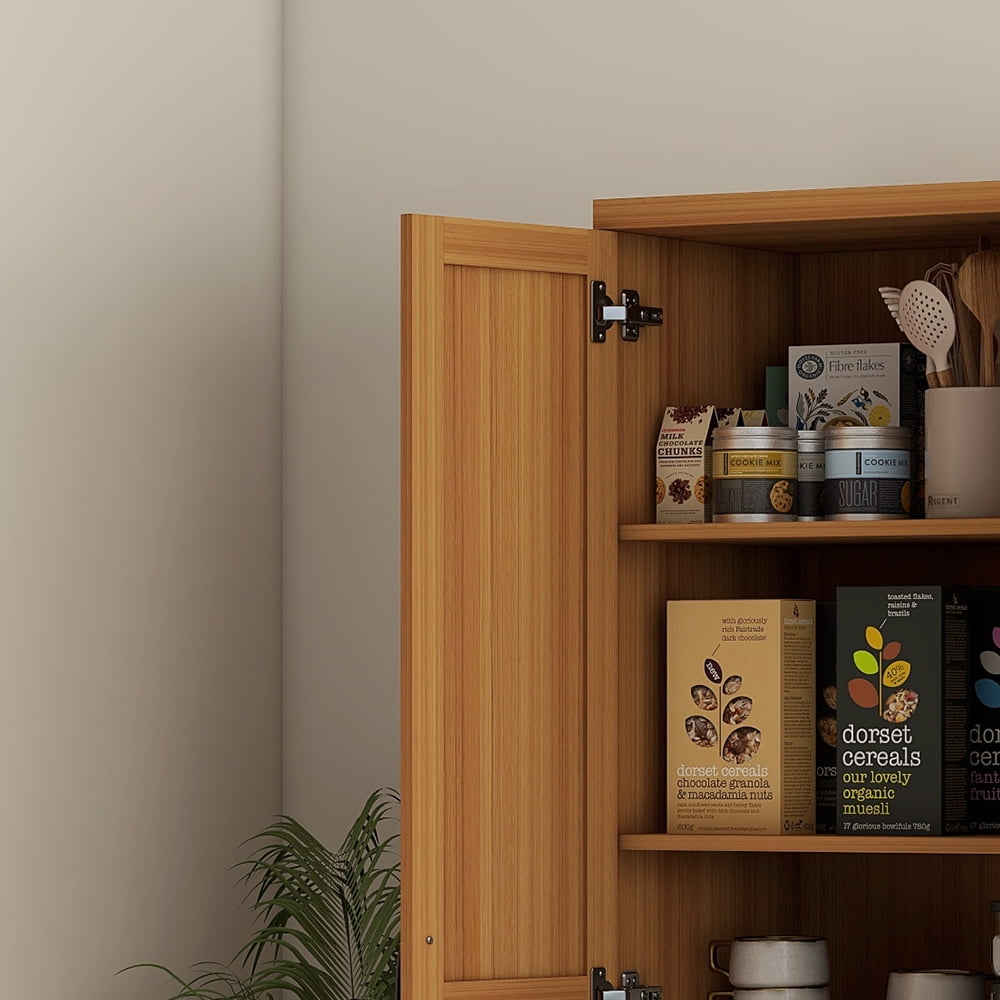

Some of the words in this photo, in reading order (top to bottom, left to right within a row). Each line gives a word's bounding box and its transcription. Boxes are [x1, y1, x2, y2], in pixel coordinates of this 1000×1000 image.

[829, 360, 854, 373] Fibre
[856, 358, 885, 371] flakes
[657, 447, 703, 456] CHUNKS
[730, 458, 764, 467] COOKIE
[765, 458, 782, 467] MIX
[864, 458, 897, 467] COOKIE
[838, 480, 878, 508] SUGAR
[705, 661, 721, 681] new
[842, 723, 913, 745] dorset
[842, 746, 922, 767] cereals
[676, 764, 719, 777] dorset
[721, 764, 768, 777] cereals
[676, 777, 727, 789] chocolate
[729, 777, 771, 790] granola
[842, 772, 868, 784] our
[870, 770, 912, 786] lovely
[676, 790, 688, 800] &
[688, 789, 748, 800] macadamia
[749, 790, 774, 800] nuts
[842, 786, 895, 802] organic
[842, 802, 891, 815] muesli
[852, 822, 881, 831] glorious
